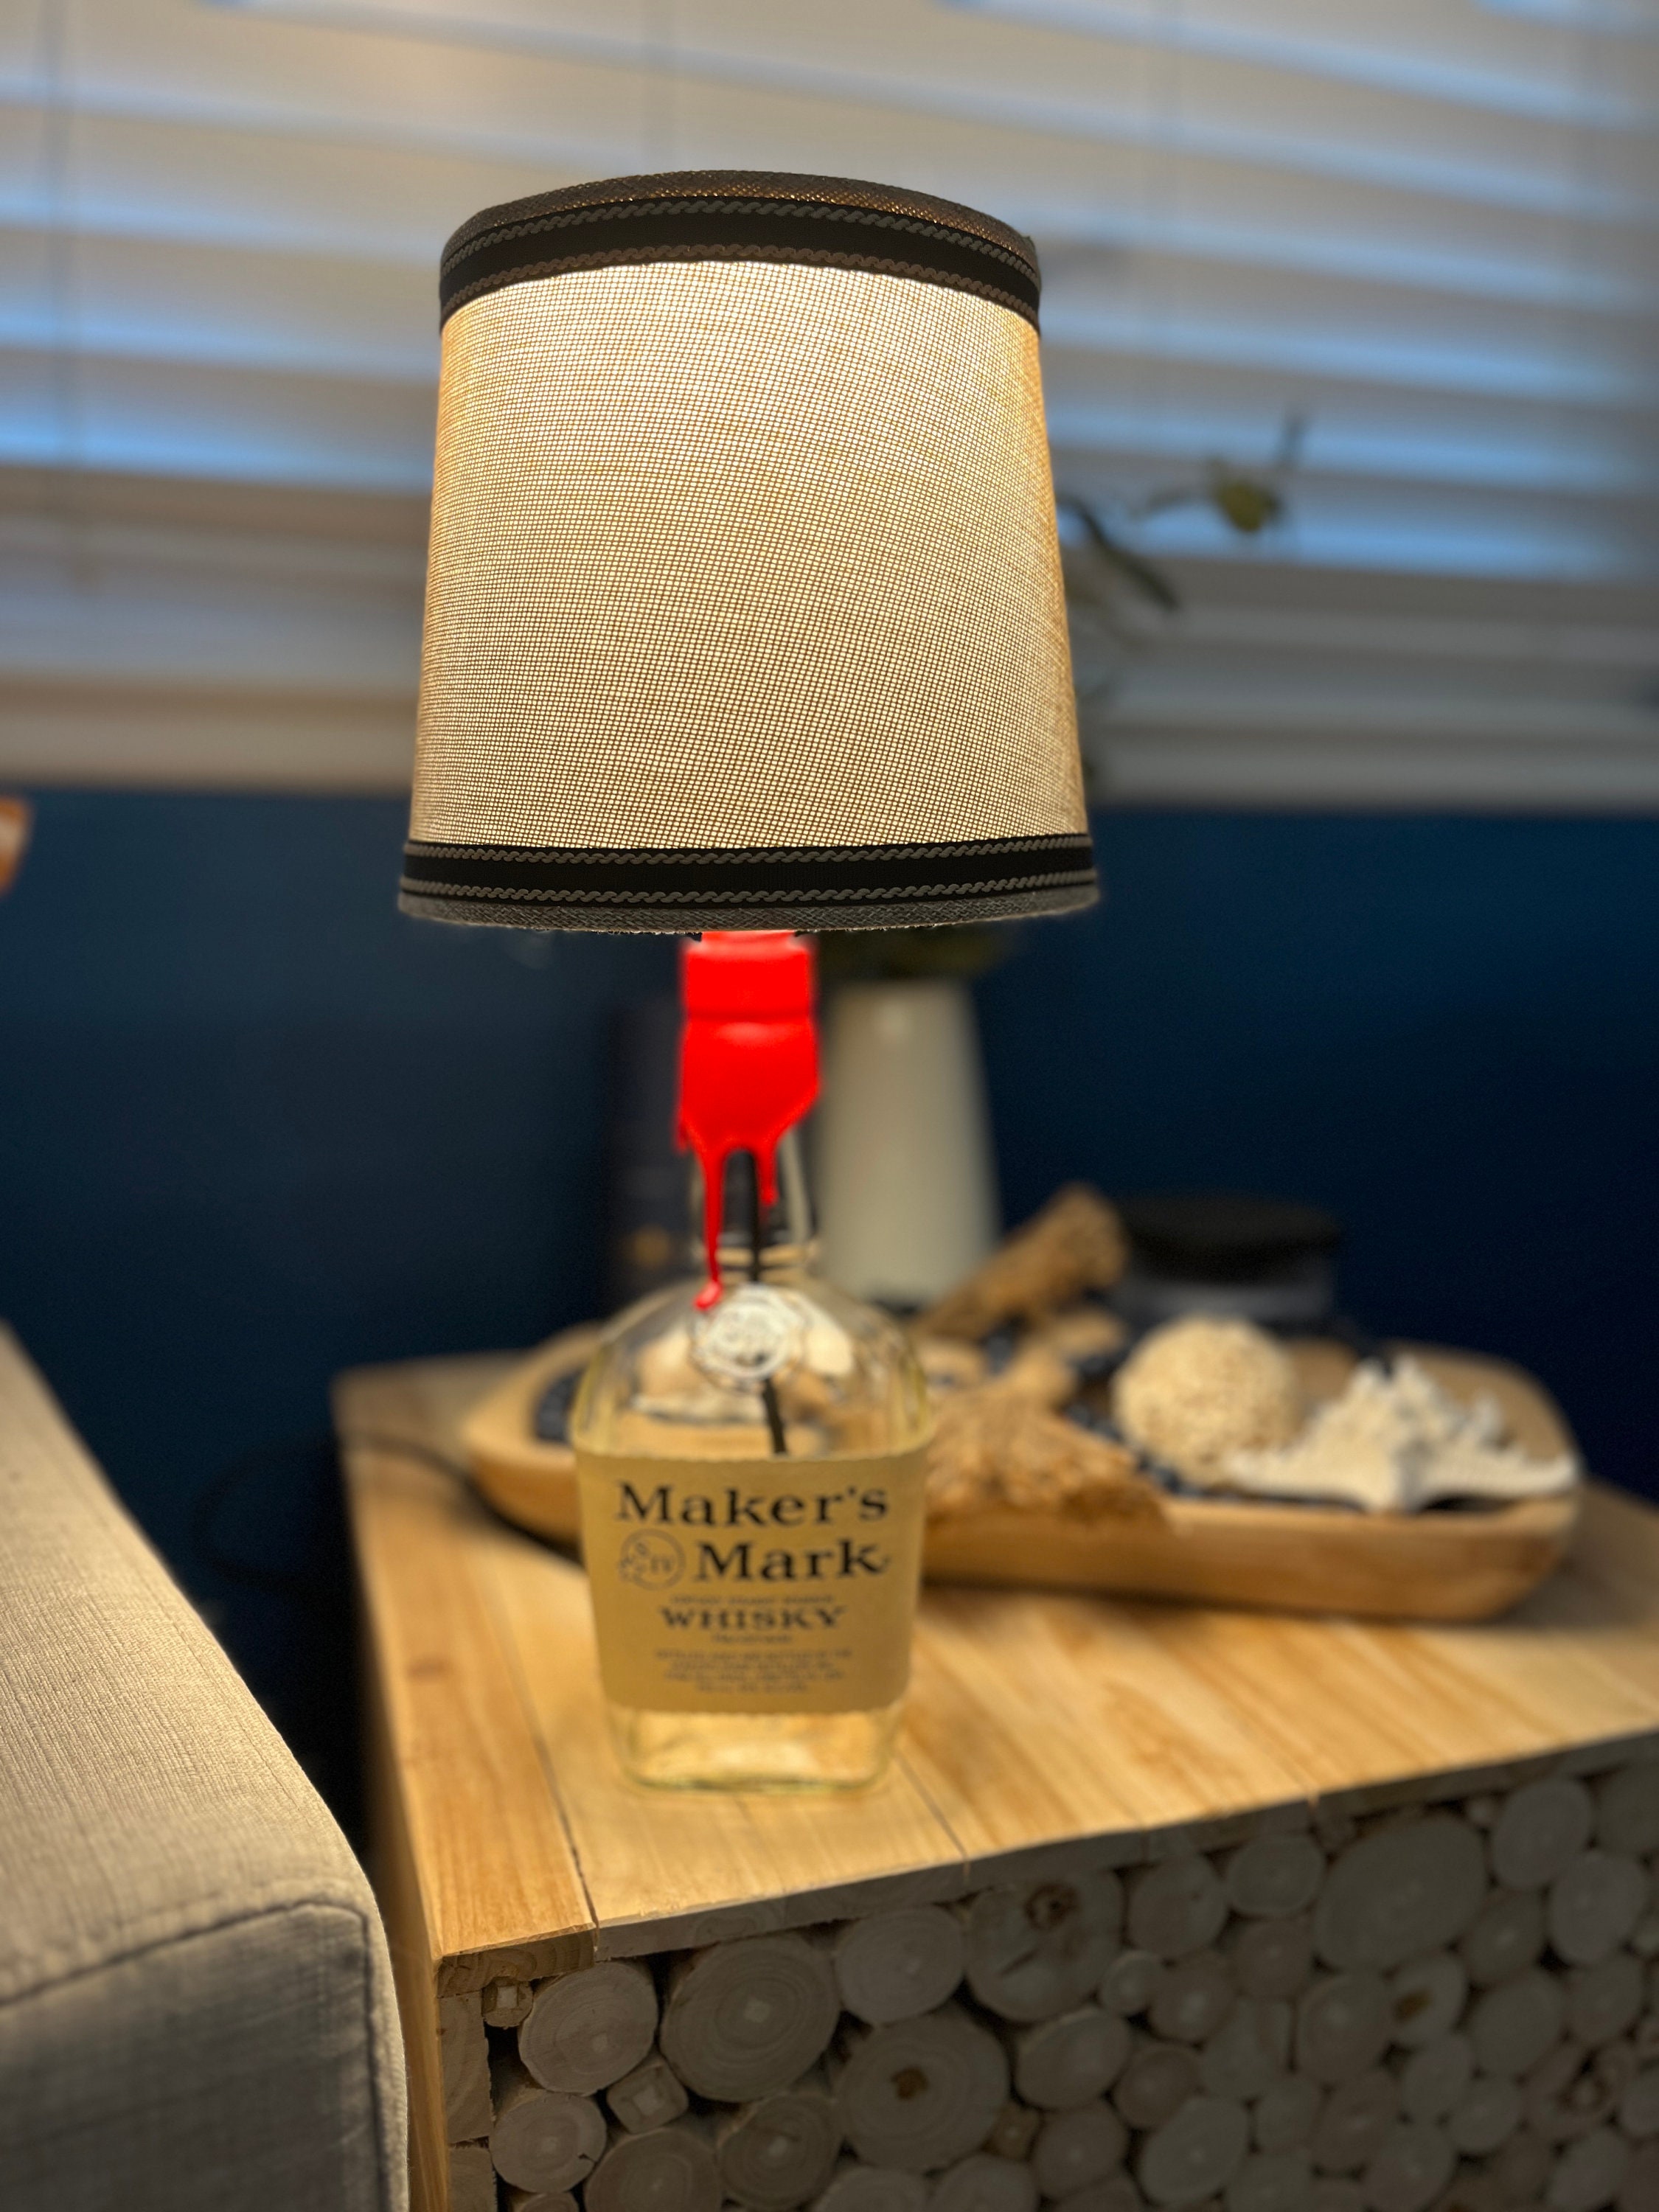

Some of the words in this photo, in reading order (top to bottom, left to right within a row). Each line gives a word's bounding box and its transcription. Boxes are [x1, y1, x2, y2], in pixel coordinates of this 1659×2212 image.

[618, 1481, 889, 1527] Maker's
[695, 1538, 891, 1583] Mark
[659, 1605, 846, 1630] WHISKY
